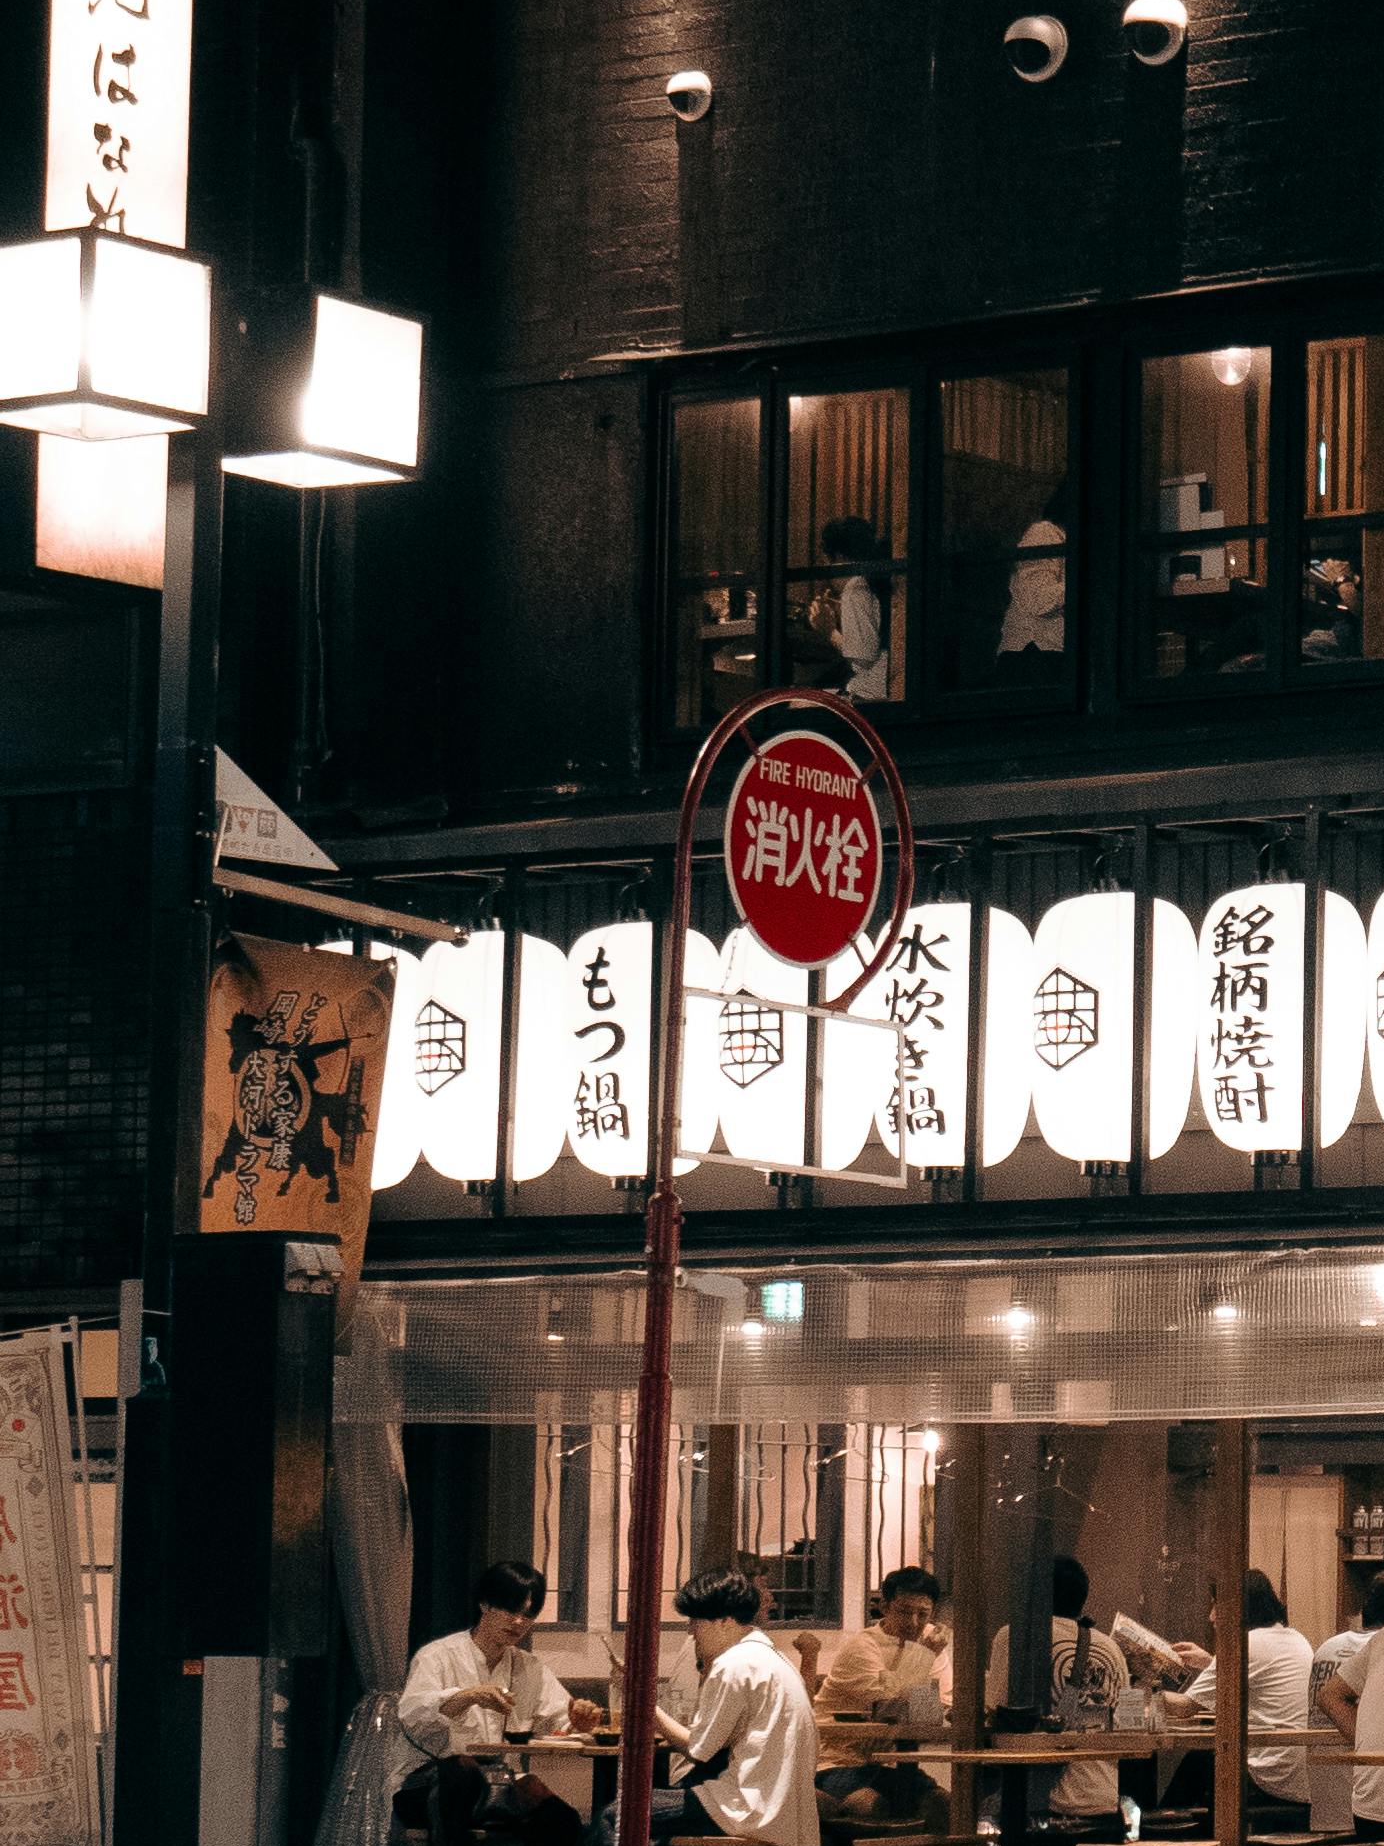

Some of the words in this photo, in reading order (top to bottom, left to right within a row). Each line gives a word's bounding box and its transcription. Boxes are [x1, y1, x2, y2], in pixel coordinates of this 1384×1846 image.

[742, 795, 870, 903] 消火栓
[759, 758, 791, 786] FIRE
[796, 765, 860, 801] HYDRANT
[267, 992, 328, 1172] どうする家康
[573, 946, 630, 1141] もつ鍋
[884, 923, 951, 1137] 水炊き鍋
[1209, 905, 1276, 1126] 銘柄焼酎
